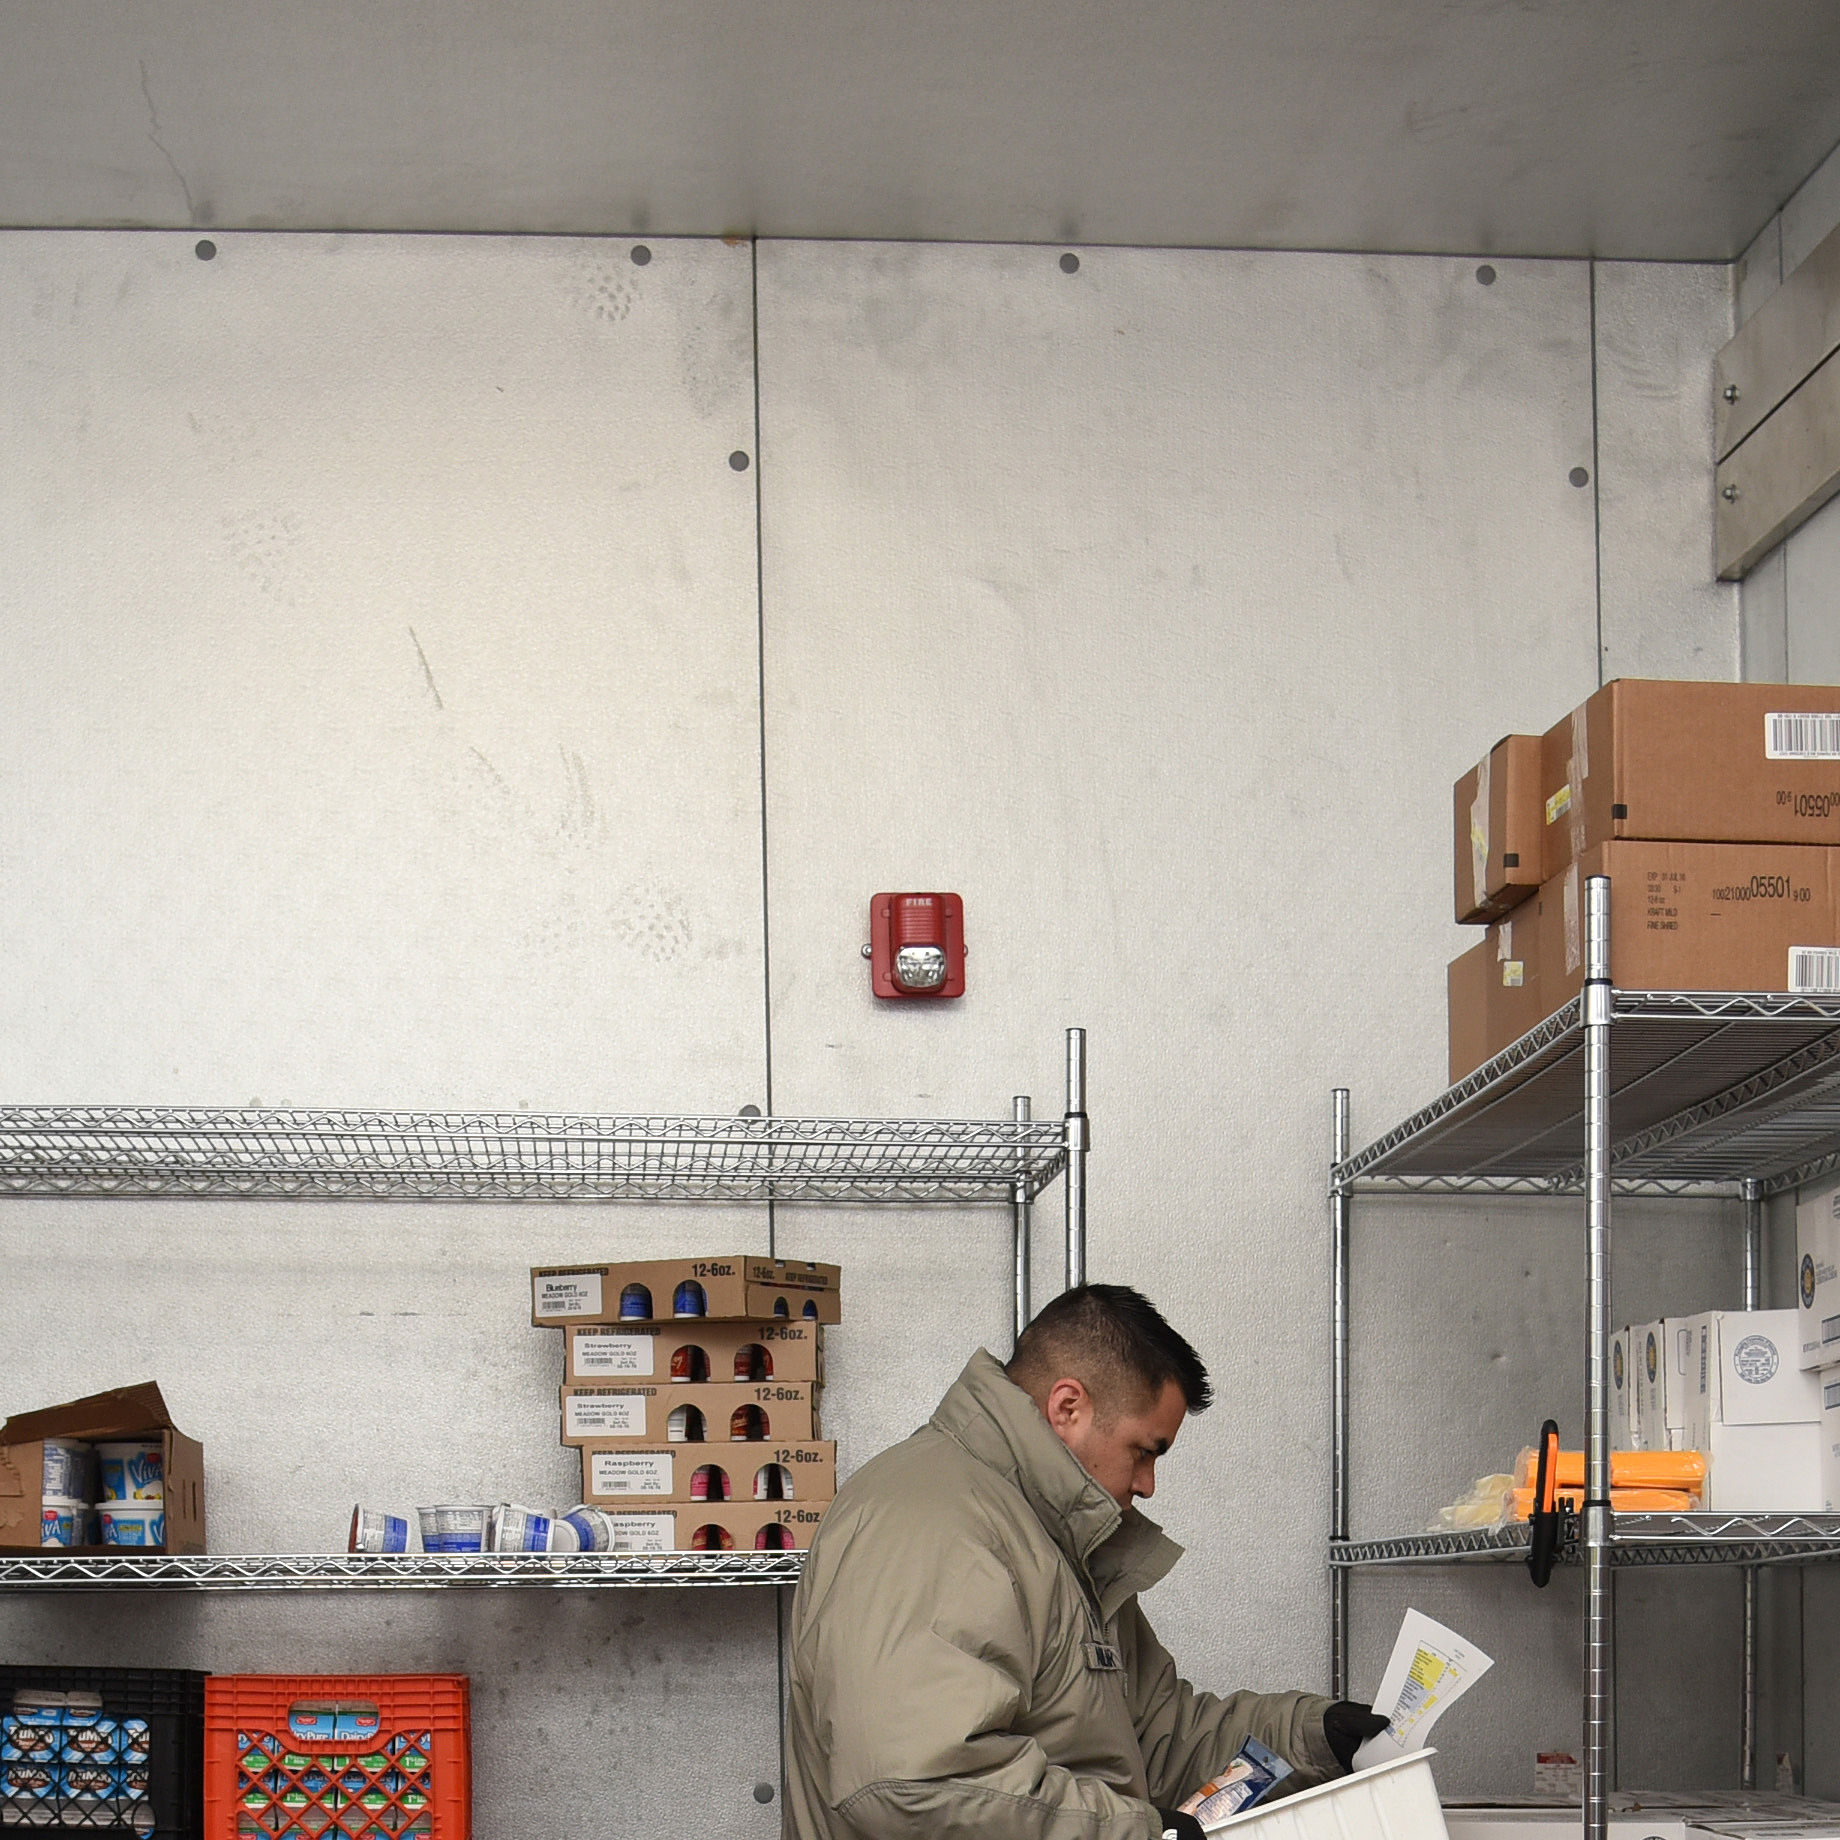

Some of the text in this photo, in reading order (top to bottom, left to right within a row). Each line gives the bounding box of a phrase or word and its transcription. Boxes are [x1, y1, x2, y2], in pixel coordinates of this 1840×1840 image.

[905, 898, 933, 906] FIRE
[692, 1262, 736, 1277] 12-6oz.
[545, 1283, 578, 1293] Blueberry
[577, 1326, 661, 1337] KEEP REFRIGERATED
[759, 1327, 808, 1341] 12-6oz.
[584, 1342, 632, 1350] Strawberry
[573, 1387, 658, 1397] KEEP REFRIGERATED
[754, 1386, 805, 1401] 12-6oz.
[576, 1402, 625, 1410] Strawberry
[774, 1449, 823, 1464] 12-6oz.
[604, 1459, 654, 1468] Raspberry
[612, 1520, 656, 1530] aspberry
